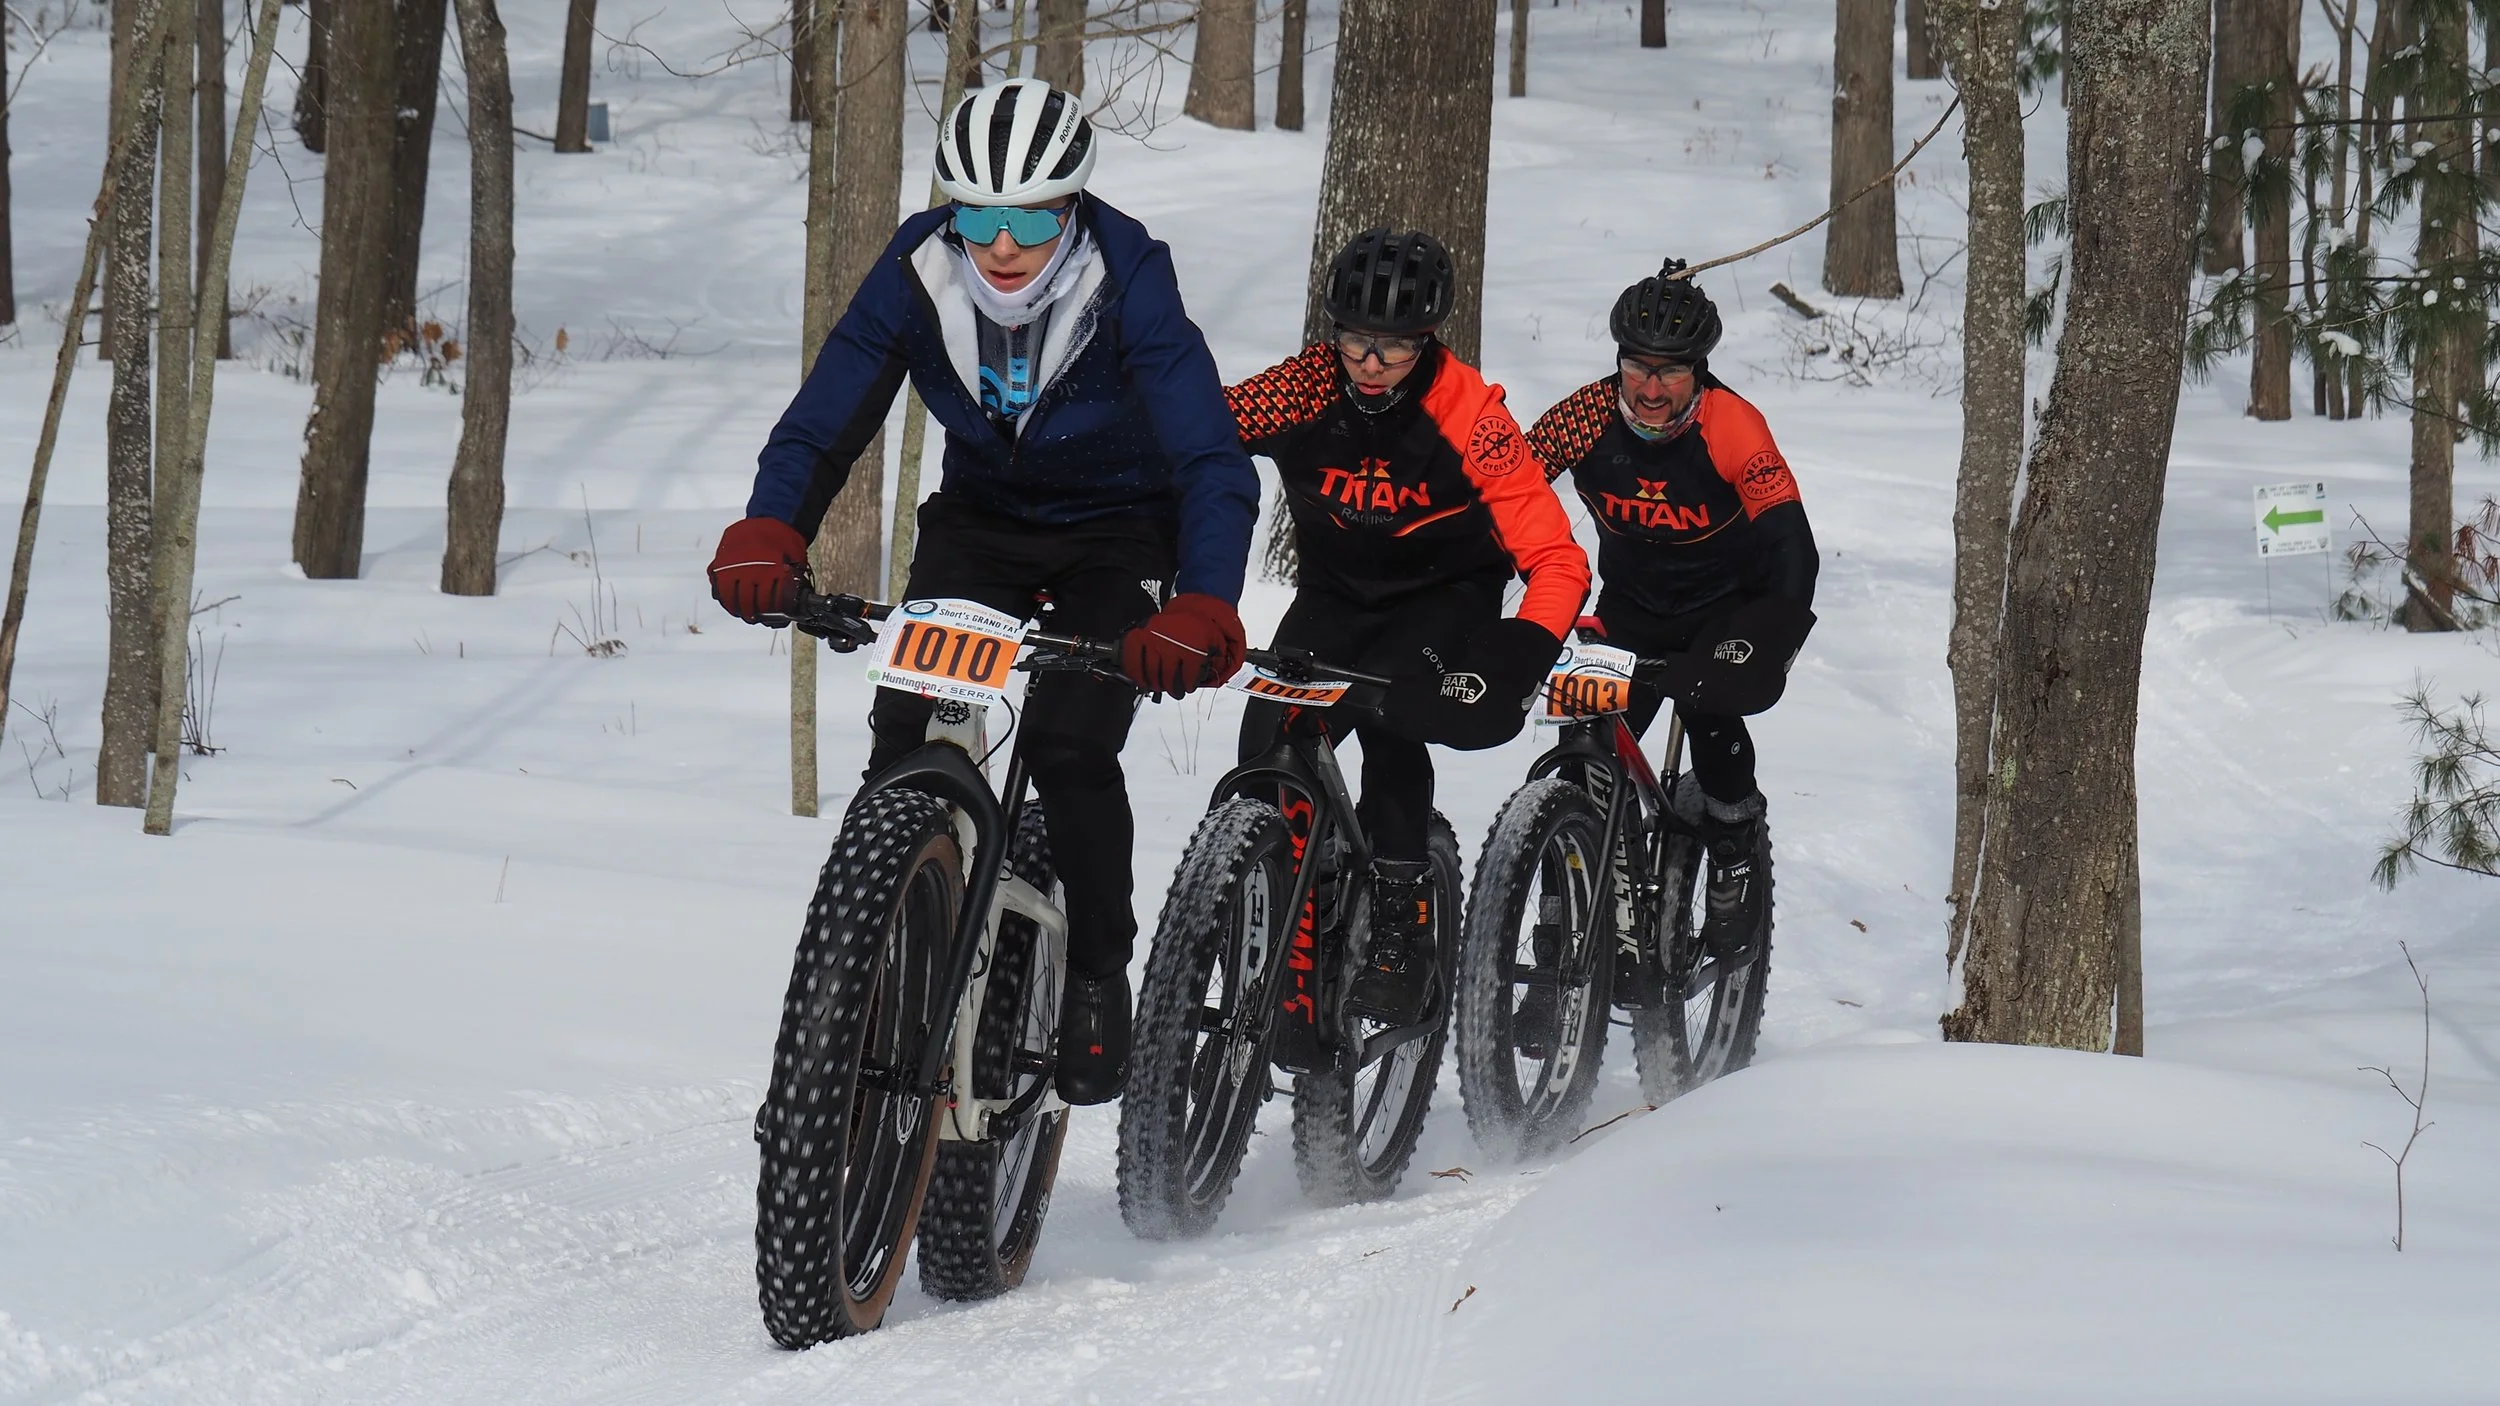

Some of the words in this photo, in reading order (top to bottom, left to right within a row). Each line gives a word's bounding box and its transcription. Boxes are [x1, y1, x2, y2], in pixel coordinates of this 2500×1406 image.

[1471, 420, 1507, 453] INERTIA
[1482, 439, 1520, 471] CYCLEWORKS
[1317, 467, 1431, 514] TITAN
[1600, 491, 1710, 530] TITAN
[939, 608, 970, 621] Short's
[972, 614, 1002, 629] GRAND
[1003, 624, 1020, 635] FAT
[892, 623, 1002, 683] 1010
[1713, 650, 1745, 661] MITTS
[1714, 642, 1737, 652] BAR
[881, 671, 937, 691] Huntington
[949, 686, 995, 701] SERRA
[1244, 676, 1333, 702] 1002
[1440, 686, 1477, 700] MITTS
[1443, 676, 1468, 687] BAR
[1547, 676, 1618, 717] 1003
